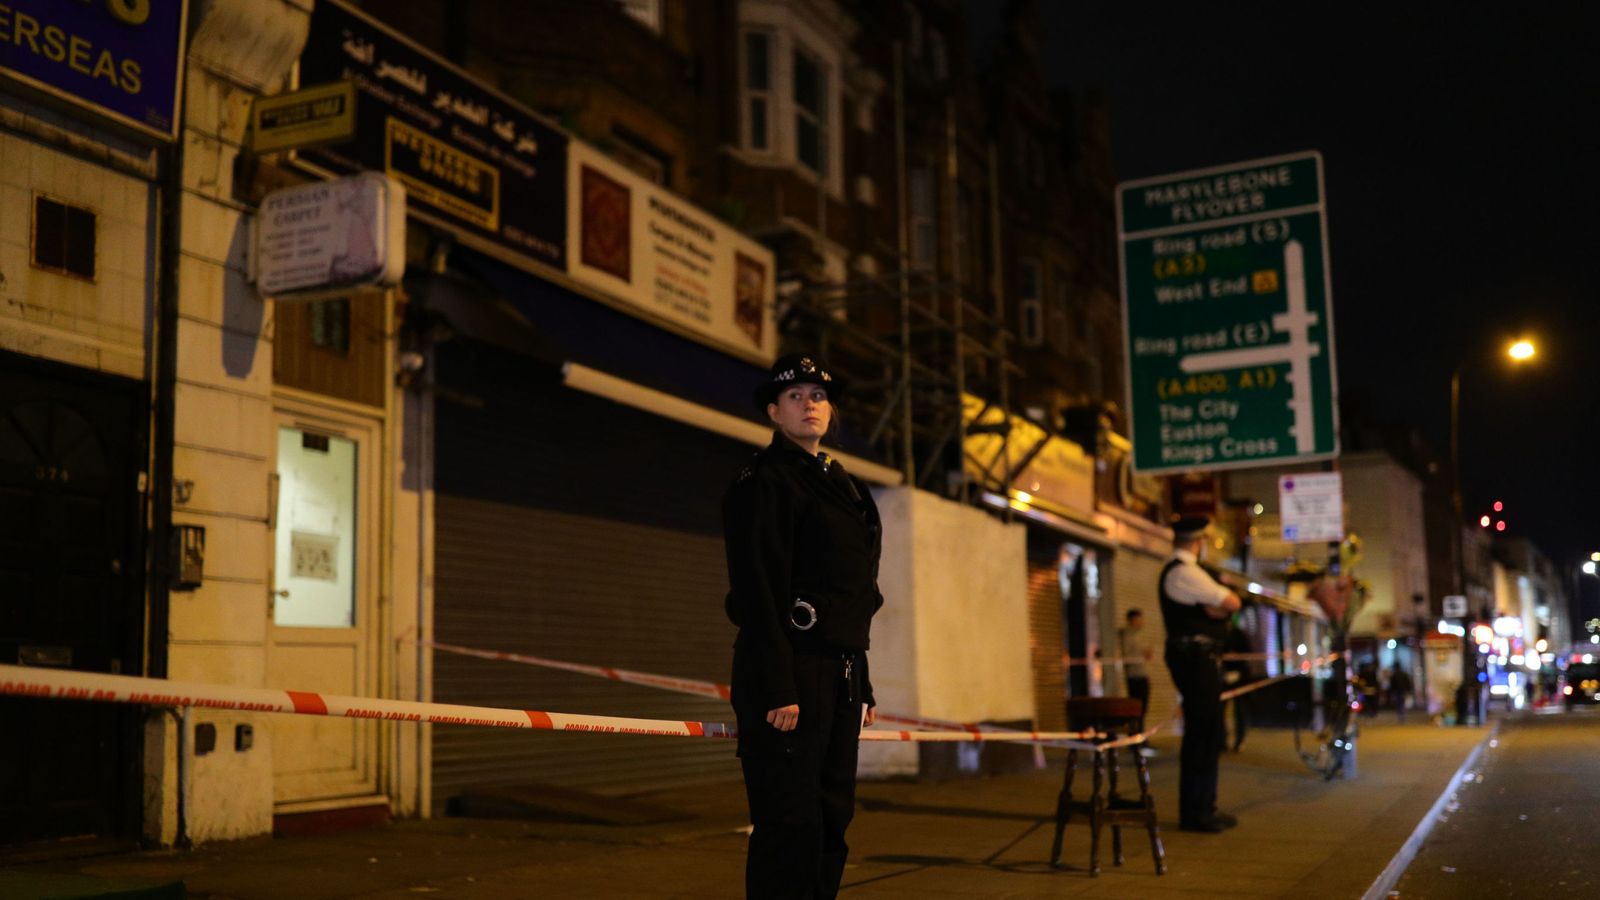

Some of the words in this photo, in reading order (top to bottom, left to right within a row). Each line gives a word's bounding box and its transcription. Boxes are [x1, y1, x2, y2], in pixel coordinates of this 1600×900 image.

[1144, 167, 1293, 206] MARYLEBONE
[1171, 192, 1265, 222] FLYOVER
[1152, 237, 1196, 256] Ring
[1201, 228, 1246, 248] road
[1155, 280, 1203, 304] West
[1209, 276, 1248, 298] End
[1134, 336, 1177, 355] Ring
[1182, 328, 1228, 348] road
[1232, 321, 1270, 346] (E)
[1239, 366, 1278, 391] A1)
[1159, 402, 1194, 421] The
[1198, 399, 1240, 421] City
[1160, 421, 1229, 443] Euston
[1161, 443, 1215, 465] Kings
[1219, 436, 1279, 458] Cross
